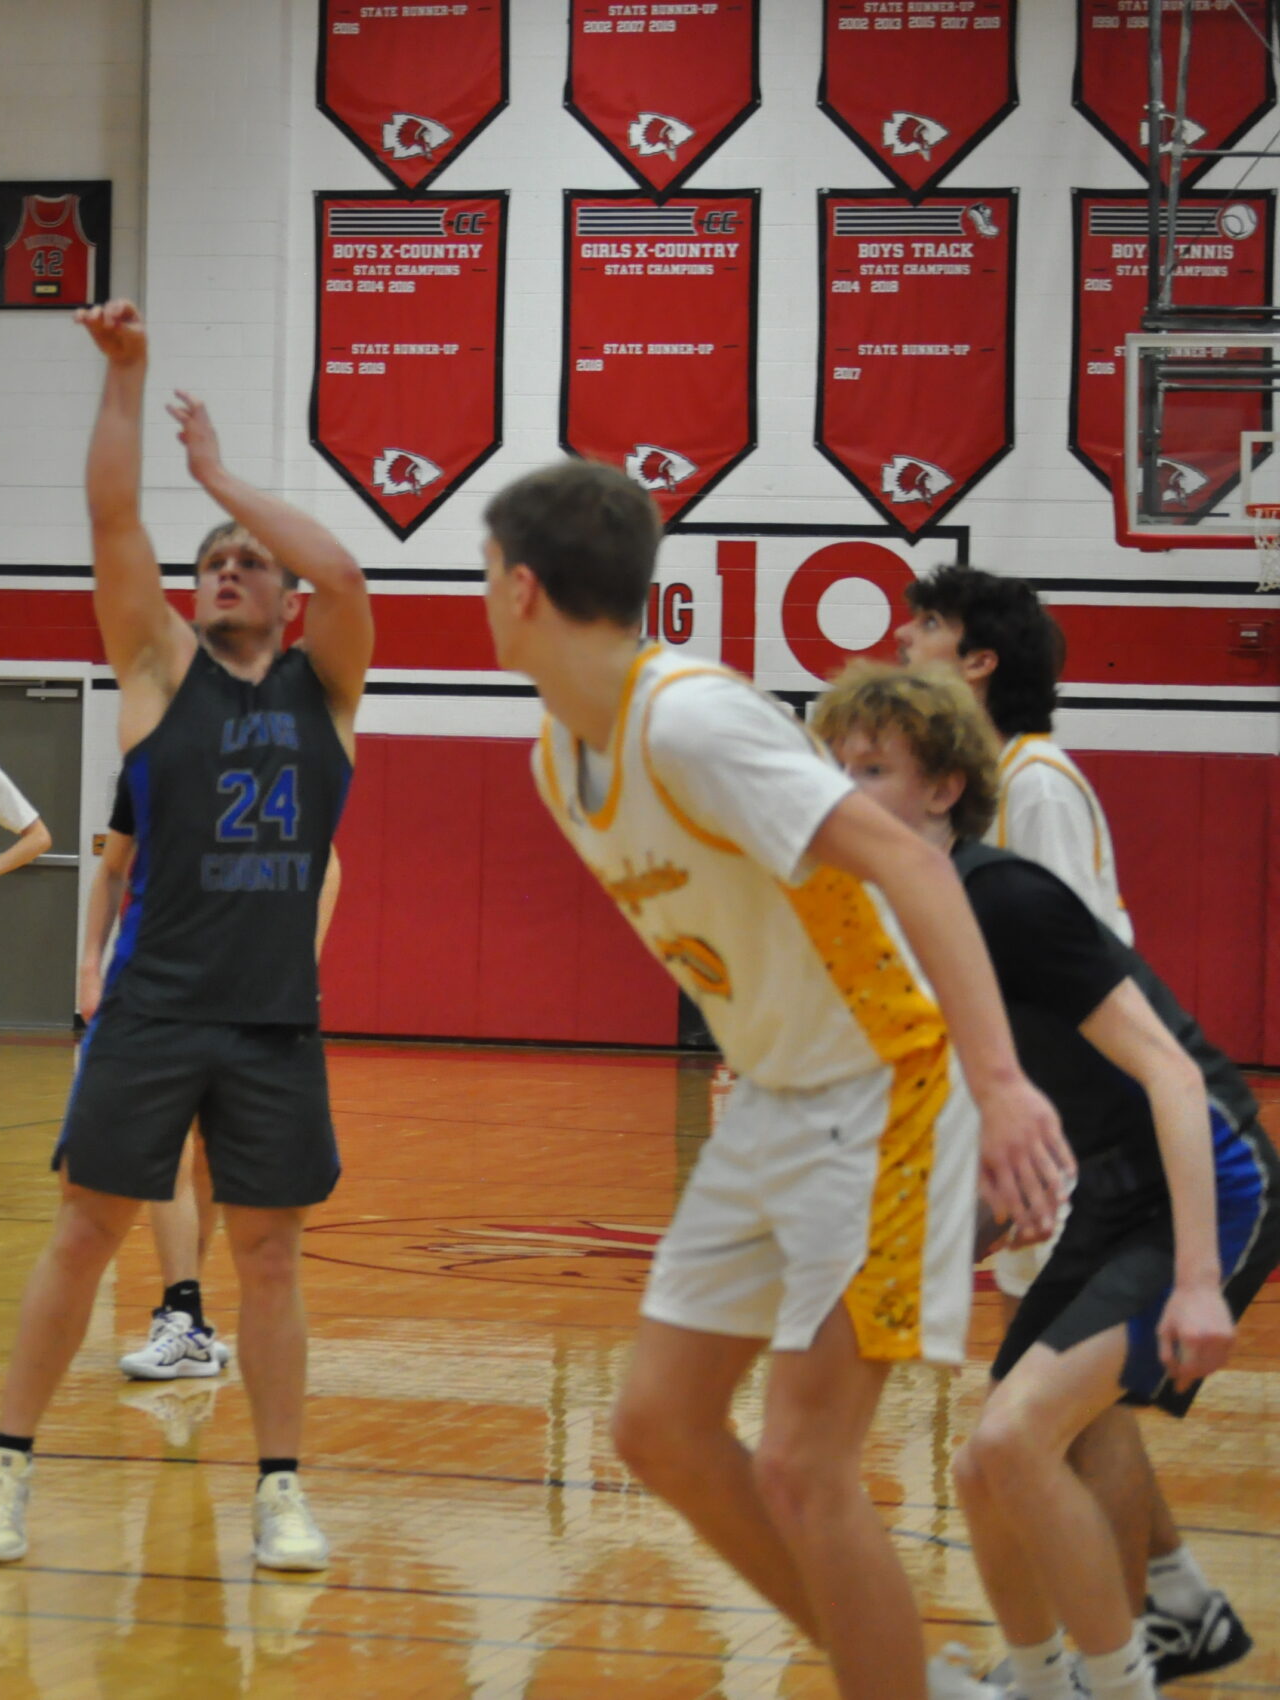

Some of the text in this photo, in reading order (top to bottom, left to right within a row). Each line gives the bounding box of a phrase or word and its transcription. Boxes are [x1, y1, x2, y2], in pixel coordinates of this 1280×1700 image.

[360, 5, 468, 17] STATE RUNNER-UP
[608, 3, 718, 16] STATE RUNNER-UP
[864, 1, 975, 13] STATE RUNNER-UP
[1117, 0, 1149, 11] STAT
[332, 243, 483, 259] BOYS X-COUNTRY
[581, 242, 739, 258] GIRLS X-COUNTRY
[858, 243, 974, 258] BOYS TRACK
[1112, 243, 1148, 258] BOY
[31, 250, 64, 277] 42
[604, 264, 714, 275] STATE CHAMPIONS
[860, 264, 970, 275] STATE CHAMPIONS
[353, 265, 460, 276] STATE CHAMPIONS
[1116, 265, 1228, 277] STAT CAMPIONS
[352, 344, 459, 355] STATE RUNNER-UP
[603, 344, 714, 354] STATE RUNNER-UP
[858, 344, 970, 355] STATE RUNNER-UP
[645, 582, 694, 645] IG
[216, 764, 300, 842] 24
